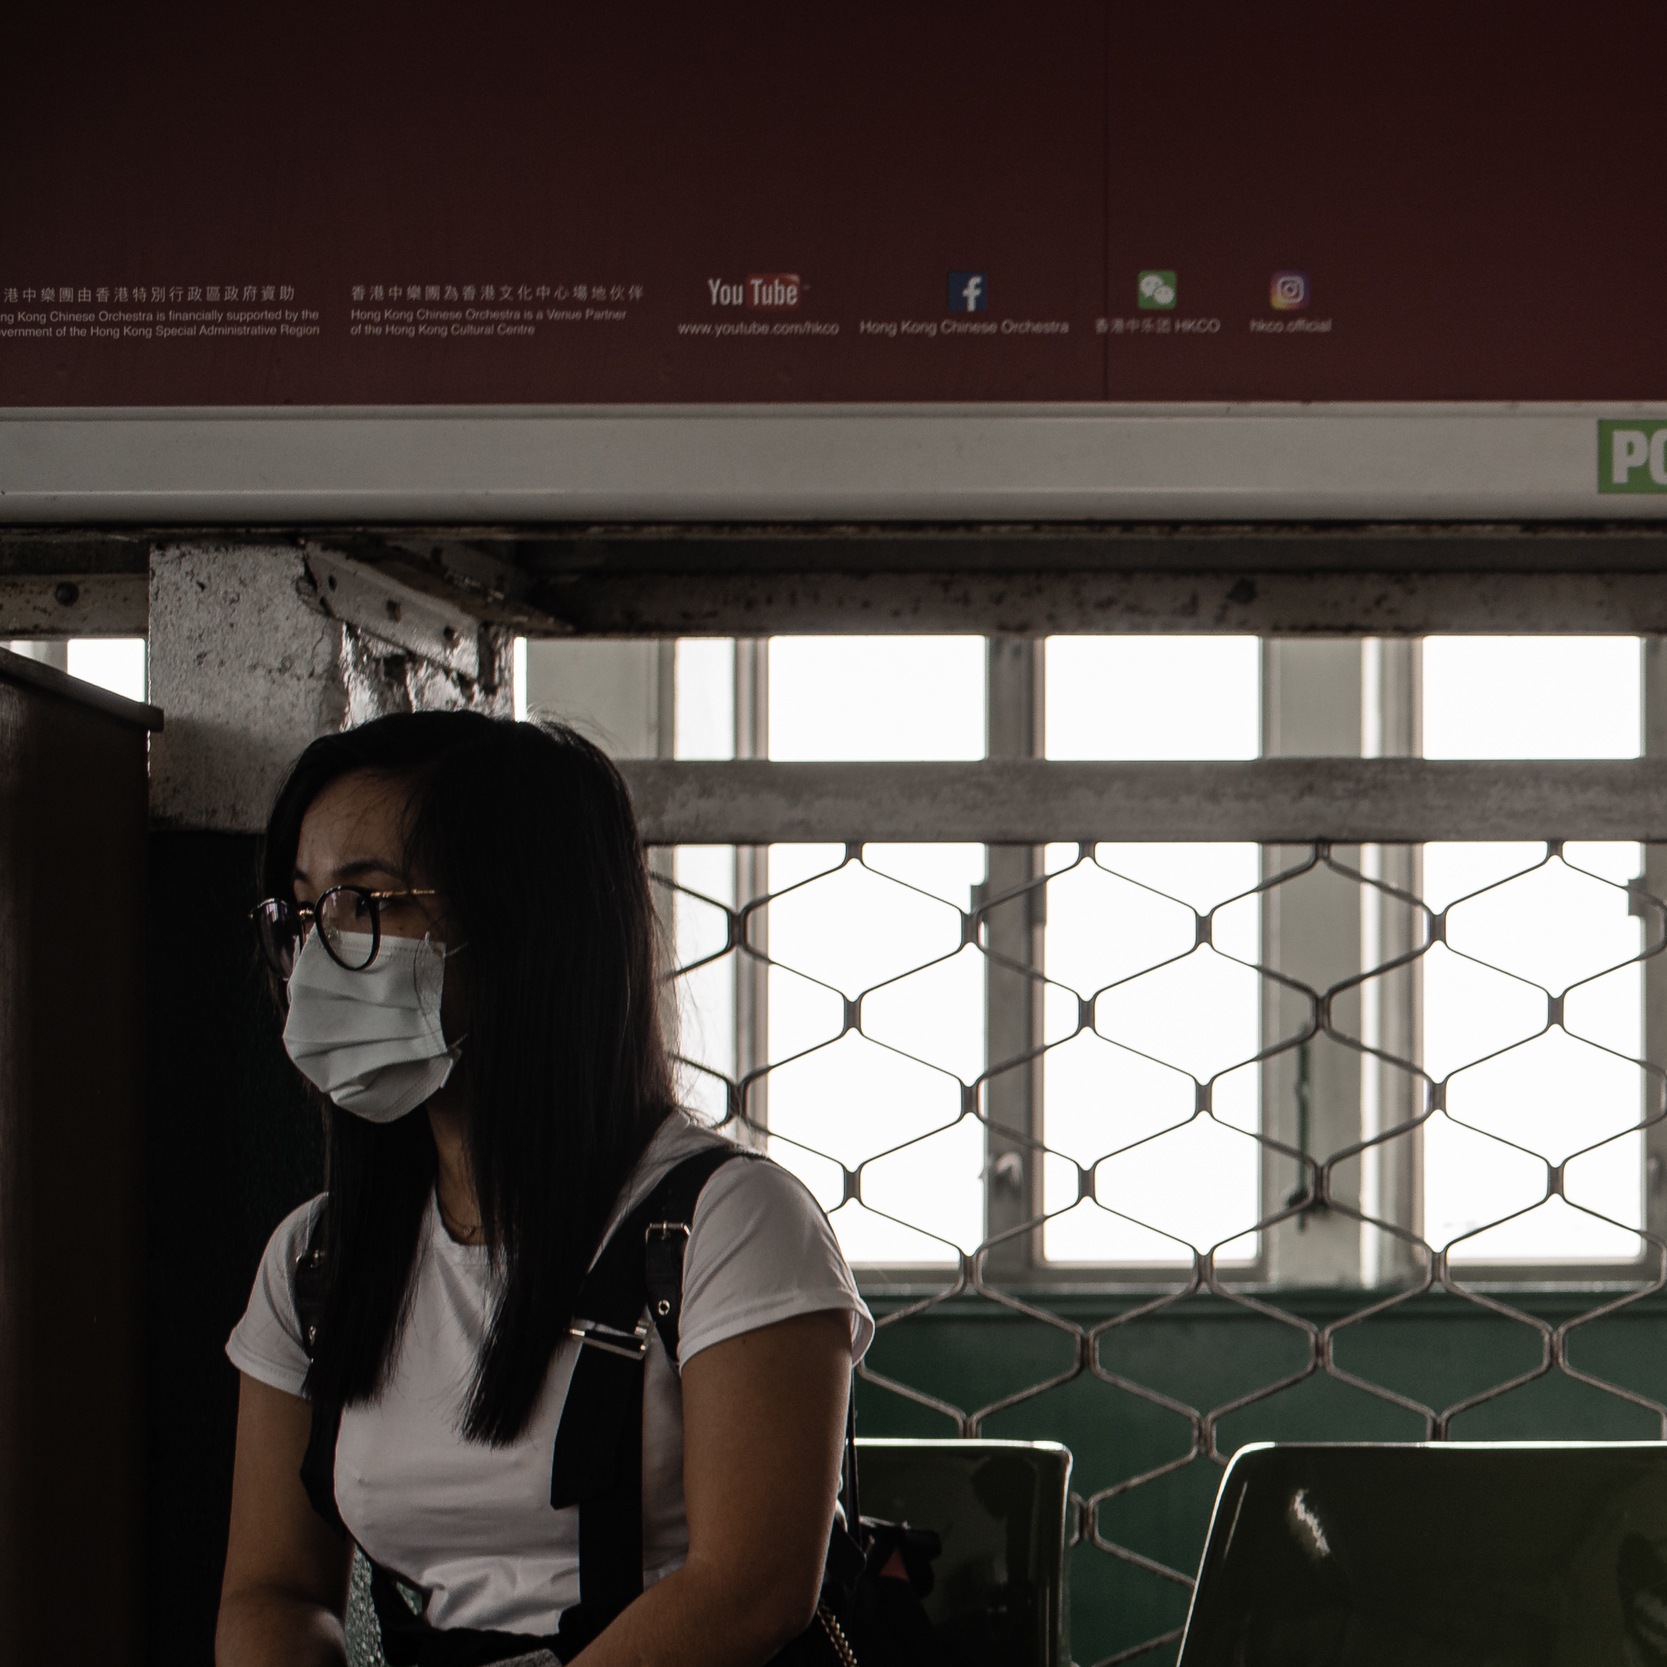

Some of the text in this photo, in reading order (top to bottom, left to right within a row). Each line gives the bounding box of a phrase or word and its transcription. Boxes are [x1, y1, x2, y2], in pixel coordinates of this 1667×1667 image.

[17, 311, 47, 325] Kong
[50, 310, 96, 322] Chinese
[99, 310, 153, 322] Orchestra
[156, 310, 166, 321] is
[168, 309, 224, 324] financially
[227, 309, 282, 323] supported
[285, 309, 299, 323] by
[302, 308, 320, 320] the
[350, 308, 627, 323] Hong Kong Chinese Orchestra is a Venue Partner
[56, 326, 67, 337] of
[70, 326, 87, 337] the
[91, 325, 120, 340] Hong
[124, 325, 153, 340] Kong
[156, 324, 197, 339] Special
[199, 324, 277, 337] Administrative
[281, 323, 320, 338] Region
[350, 323, 536, 338] of the Hong Kong Cultural Centre
[859, 319, 1070, 337] Hong Kong Chinese Orchestra
